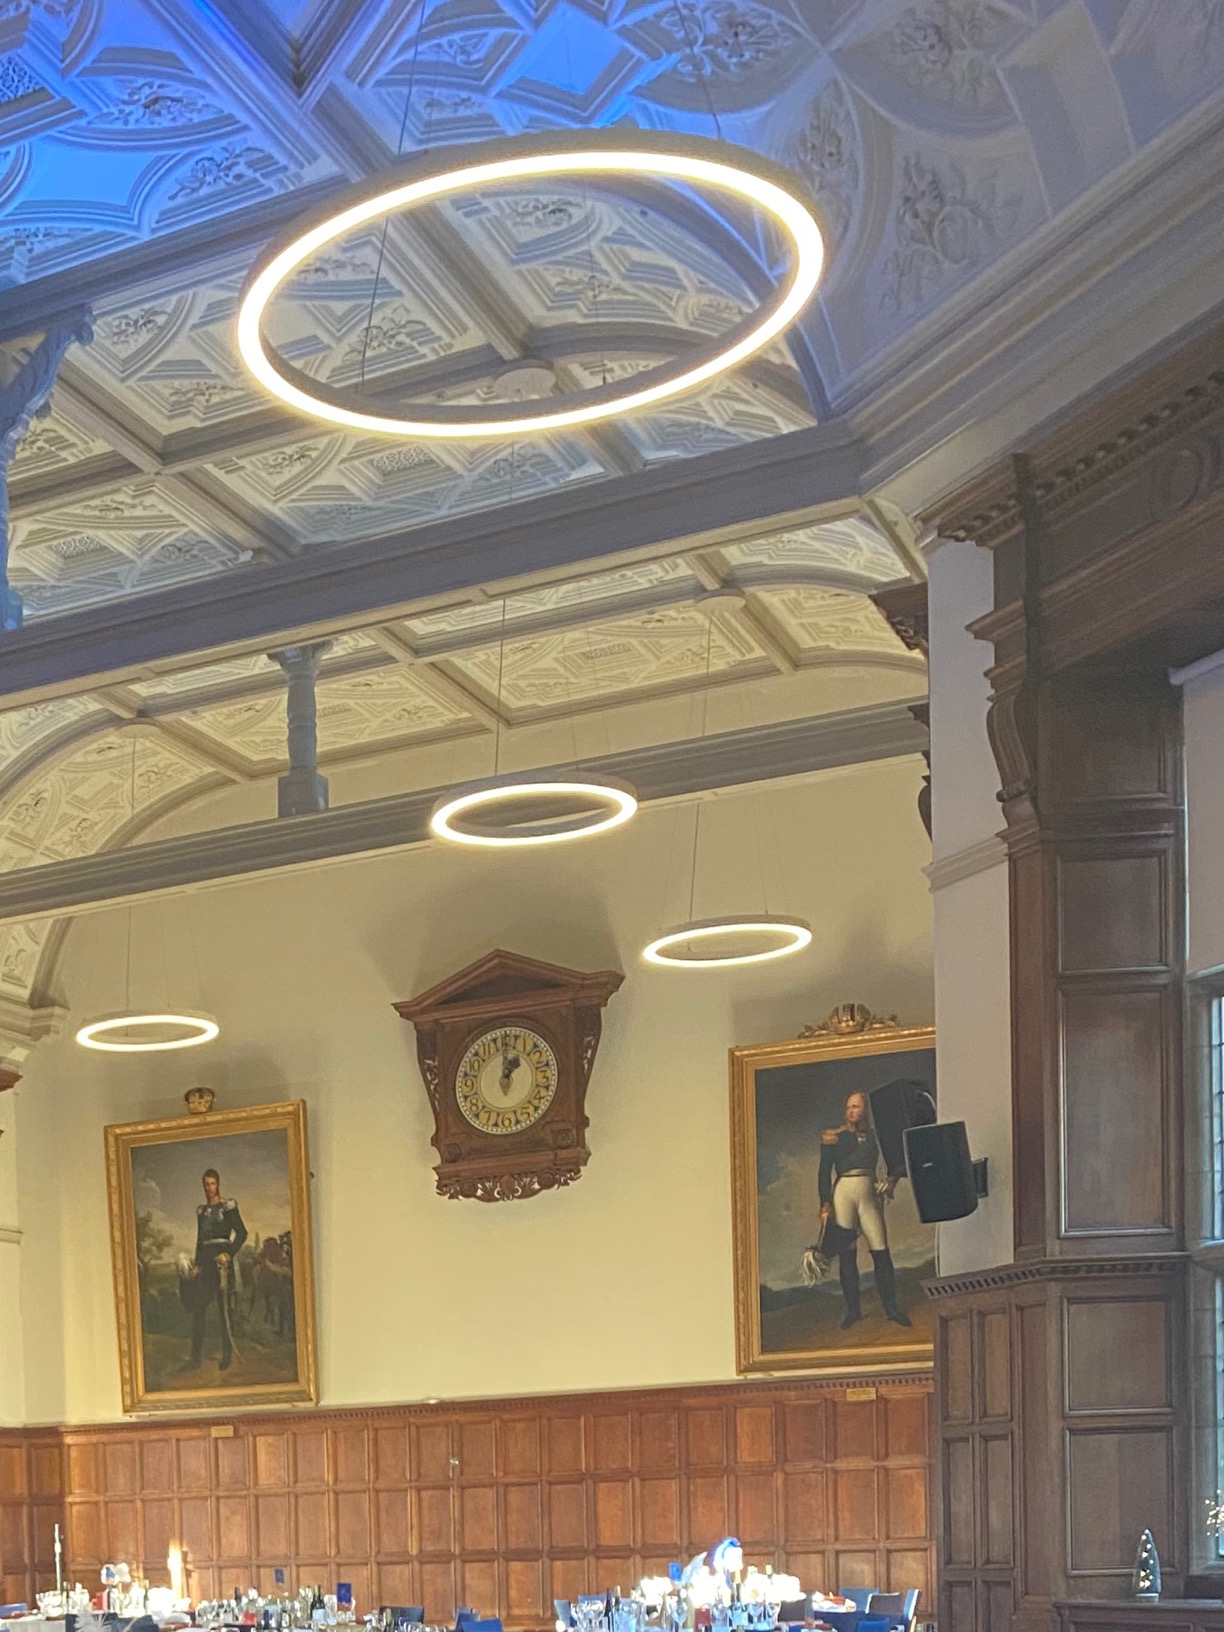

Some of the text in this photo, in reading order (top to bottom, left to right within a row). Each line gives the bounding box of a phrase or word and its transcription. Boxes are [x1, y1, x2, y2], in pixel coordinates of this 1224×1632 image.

[482, 1042, 492, 1056] 11
[532, 1050, 543, 1063] 2
[468, 1060, 481, 1073] 10
[539, 1069, 550, 1083] 3
[464, 1079, 475, 1093] 9
[534, 1089, 546, 1102] 4
[469, 1097, 479, 1111] 8
[484, 1111, 492, 1124] 7
[520, 1106, 531, 1117] 5
[501, 1111, 512, 1127] 6
